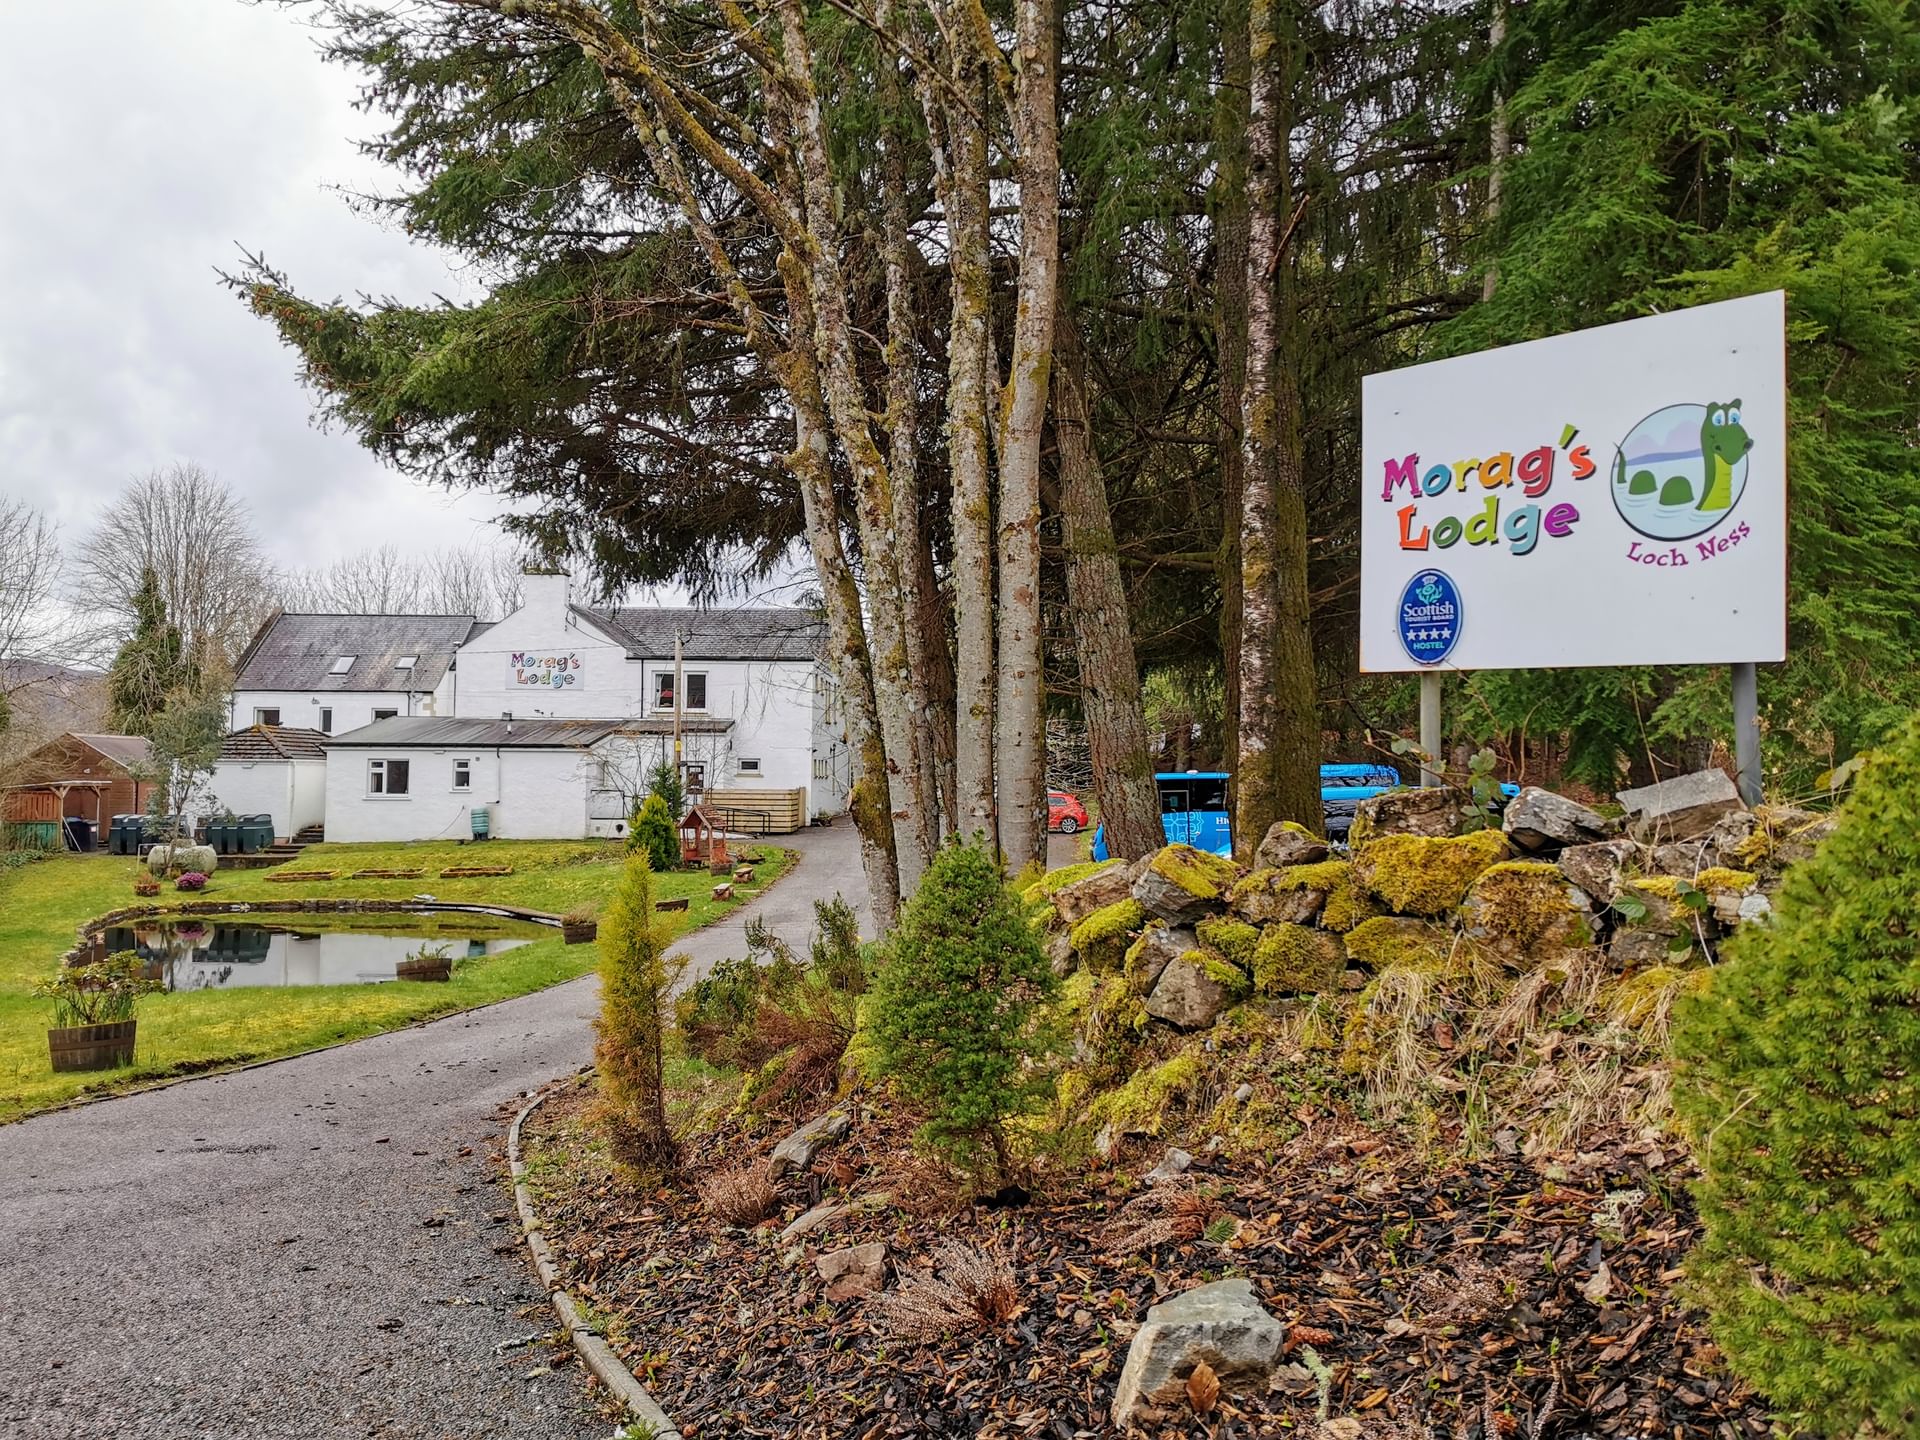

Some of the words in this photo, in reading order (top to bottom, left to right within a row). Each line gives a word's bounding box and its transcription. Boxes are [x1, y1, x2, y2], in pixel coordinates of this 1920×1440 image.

[1381, 423, 1596, 502] Morag's
[1397, 495, 1579, 556] Lodge
[1627, 542, 1689, 566] Loch
[1695, 520, 1750, 561] Ness
[1403, 600, 1454, 617] Scottish
[1413, 641, 1445, 650] HOSTEL
[511, 652, 580, 672] Morag's
[516, 668, 575, 689] Lodge
